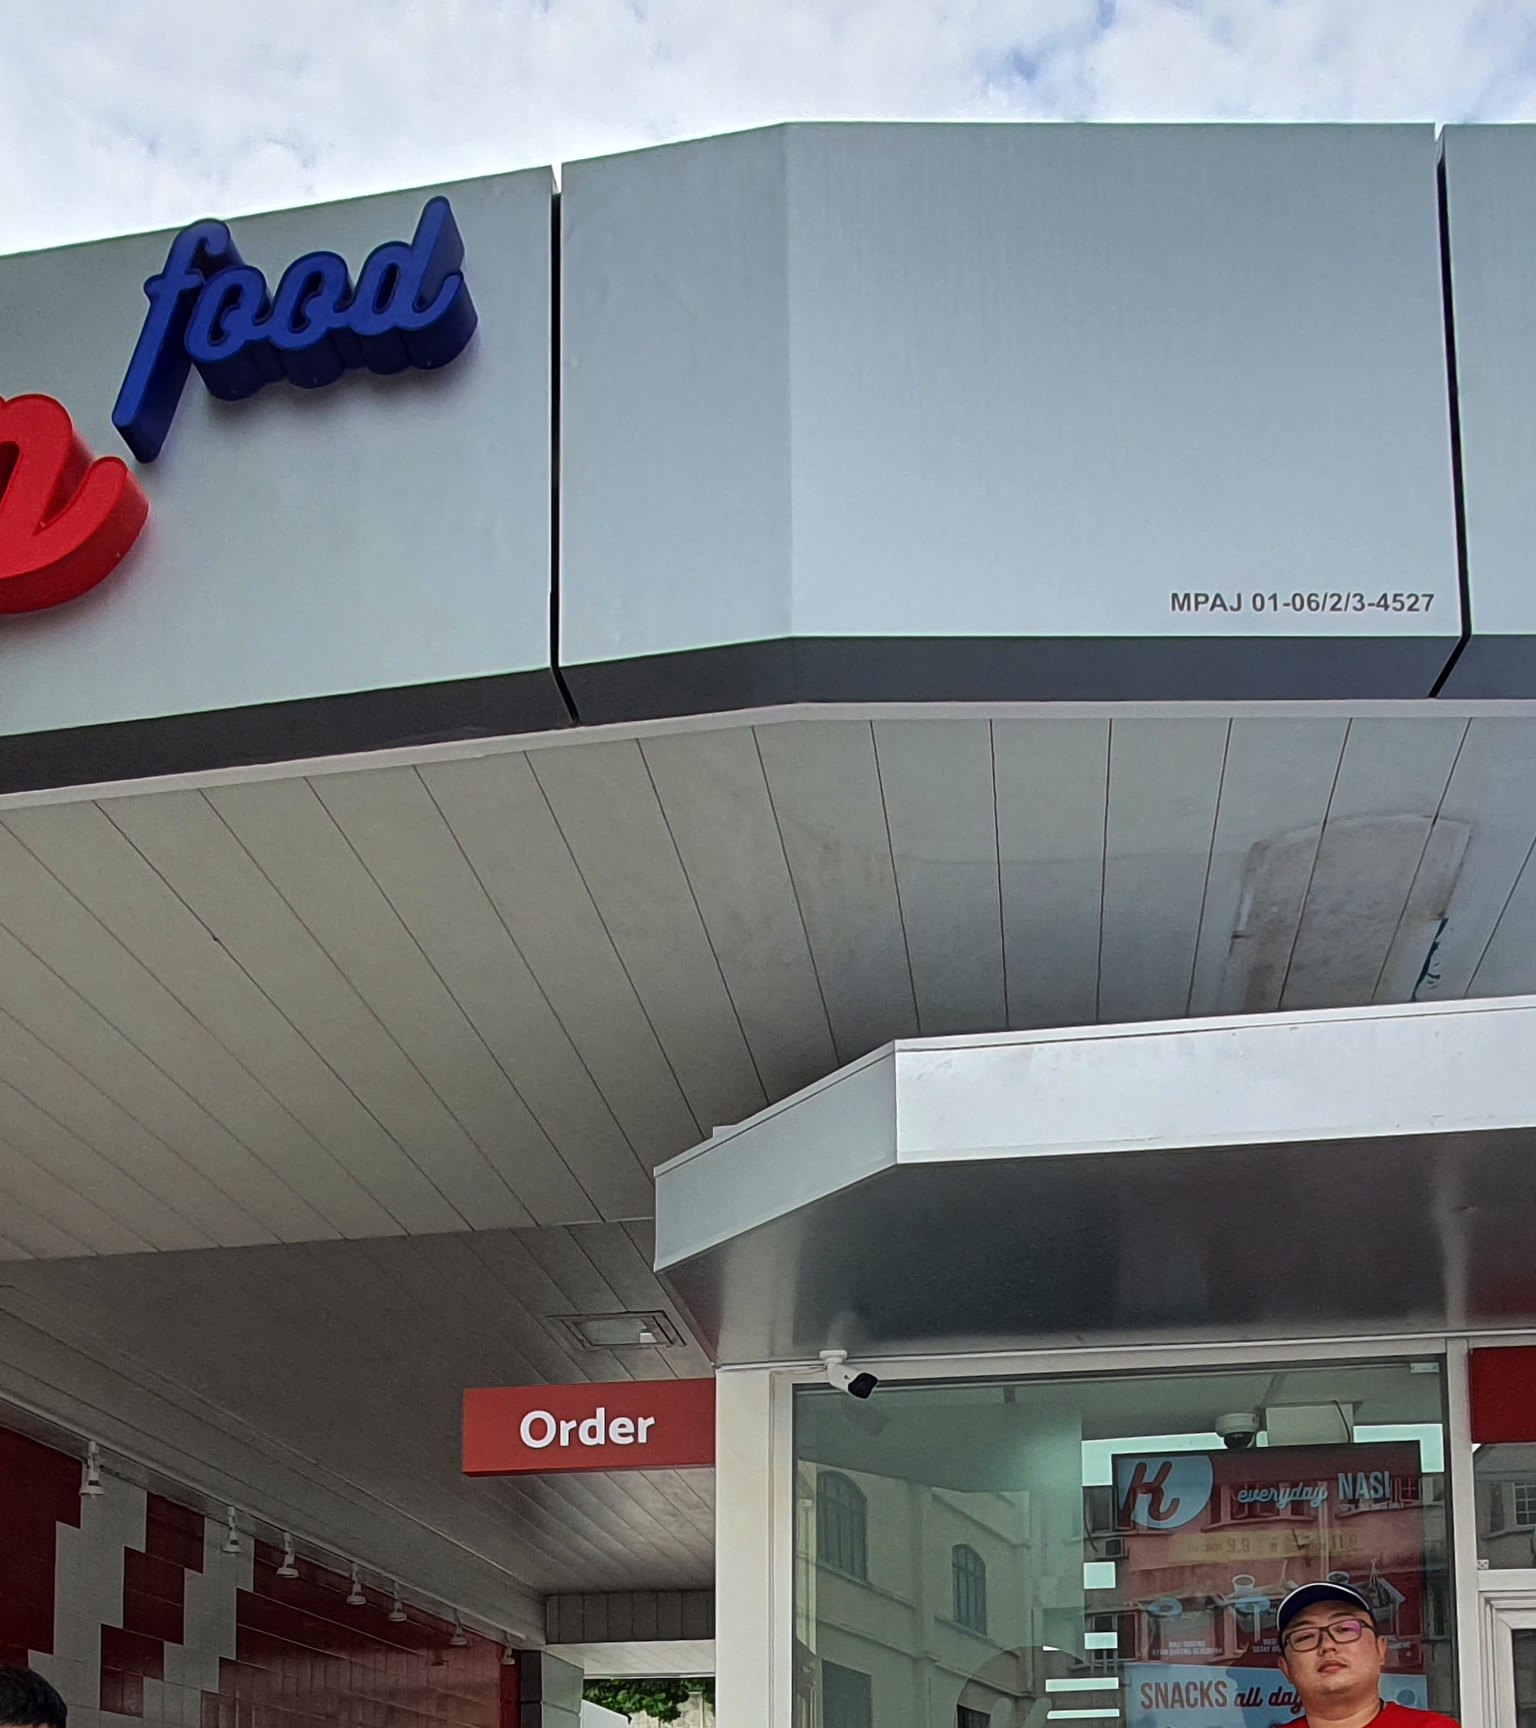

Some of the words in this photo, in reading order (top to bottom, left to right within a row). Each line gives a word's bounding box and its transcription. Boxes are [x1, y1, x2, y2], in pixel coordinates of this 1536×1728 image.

[112, 196, 478, 463] food
[1170, 592, 1243, 612] MPAJ
[1251, 592, 1435, 612] 01-06/2/3-4527
[520, 1407, 655, 1448] Order
[1237, 1482, 1328, 1509] everyday
[1337, 1471, 1391, 1500] NASI
[1140, 1681, 1227, 1709] SNACKS
[1234, 1686, 1263, 1707] all
[1268, 1686, 1303, 1714] day
